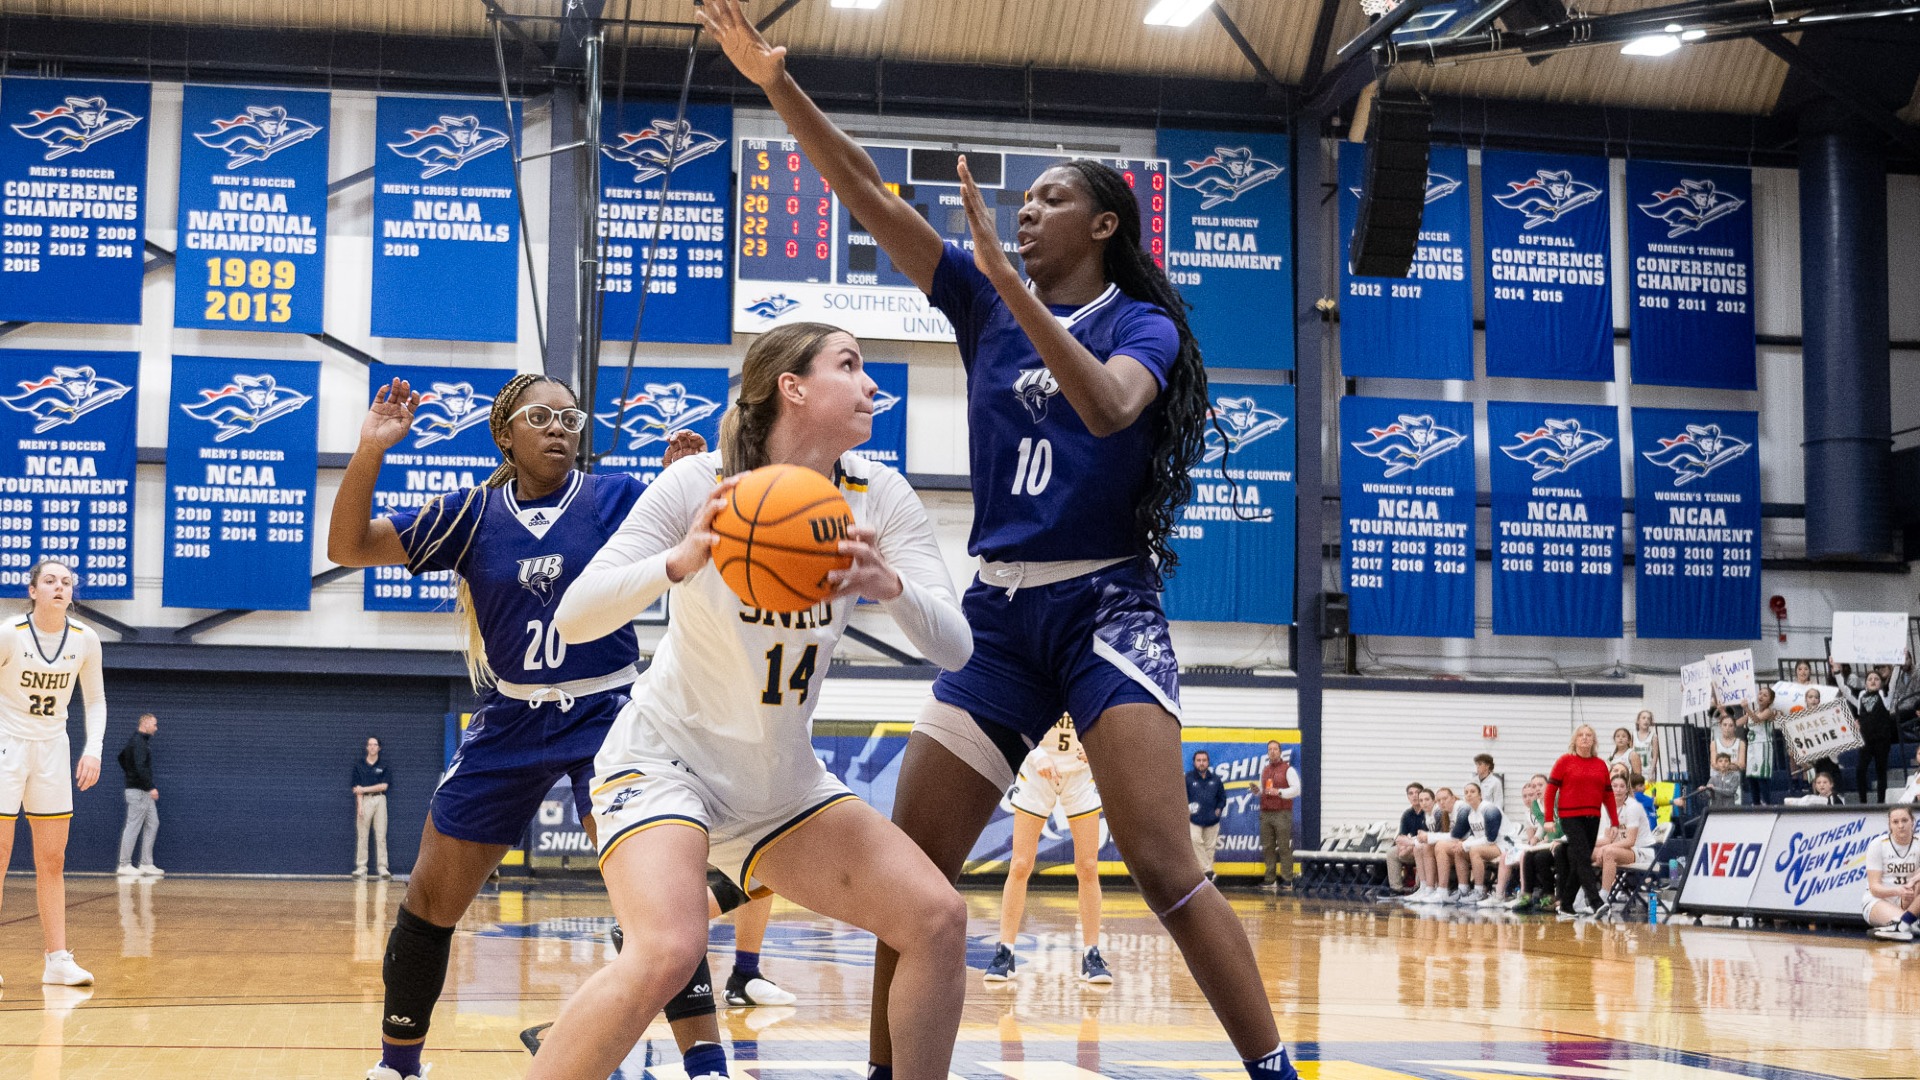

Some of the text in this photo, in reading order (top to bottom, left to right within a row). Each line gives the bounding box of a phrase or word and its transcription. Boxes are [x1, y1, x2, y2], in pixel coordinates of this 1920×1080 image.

[748, 140, 795, 152] PLYR FLS
[757, 151, 769, 170] 5
[1144, 161, 1158, 171] PTS
[30, 167, 114, 179] MEN'S SOCCER
[212, 176, 295, 188] MEN'S SOCCER
[751, 175, 769, 190] 14
[5, 181, 137, 201] CONFERENCE
[383, 184, 512, 198] MEN'S CROSS COUNTRY
[4, 199, 136, 220] CHAMPIONS
[219, 191, 287, 212] NCAA
[744, 194, 768, 213] 20
[414, 201, 481, 222] NCAA
[598, 201, 724, 223] CONFERENCE
[188, 211, 316, 235] NATIONAL
[597, 219, 723, 241] CHAMPIONS
[743, 216, 829, 238] 22 2
[1192, 216, 1258, 227] FIELD HOCKEY
[4, 223, 136, 240] 2000 2002 2008
[384, 220, 509, 242] NATIONALS
[4, 241, 132, 258] 2012 2013 2014
[186, 232, 316, 254] CHAMPIONS
[743, 238, 767, 257] 23
[1195, 232, 1256, 252] NCAA
[1519, 235, 1575, 247] SOFTBALL
[384, 244, 419, 256] 2018
[688, 249, 723, 261] 1994
[1492, 249, 1603, 268] CONFERENCE
[1648, 244, 1734, 257] WOMEN'S TENNIS
[4, 258, 39, 272] 2015
[1170, 252, 1282, 270] TOURNAMENT
[1637, 257, 1745, 277] CONFERENCE
[207, 258, 295, 289] 1989
[688, 266, 723, 278] 1999
[846, 273, 878, 285] SCORE
[1169, 272, 1201, 285] 2019
[1492, 265, 1604, 285] CHAMPIONS
[1351, 283, 1421, 298] 2012 2017
[1638, 273, 1746, 294] CHAMPIONS
[1495, 287, 1563, 302] 2014 2015
[205, 291, 292, 322] 2013
[823, 293, 920, 314] SOUTHERN
[1640, 296, 1745, 313] 2010 2011 2012
[903, 317, 955, 335] UNIVE
[19, 440, 105, 451] MEN'S SOCCER
[200, 448, 284, 460] MEN'S SOCCER
[27, 456, 97, 476] NCAA
[385, 454, 498, 467] MEN'S BASKETBALL
[601, 456, 637, 466] MEN'S
[1011, 437, 1053, 496] 10
[207, 465, 275, 486] NCAA
[407, 470, 474, 491] NCAA
[1247, 470, 1291, 481] COUNTRY
[174, 486, 306, 504] TOURNAMENT
[1197, 484, 1259, 504] NCAA
[1363, 484, 1453, 496] WOMEN'S SOCCER
[1532, 487, 1581, 497] SOFTBALL
[1655, 492, 1741, 502] WOMEN'S TENNIS
[42, 500, 127, 514] 1987 1988
[1184, 506, 1272, 522] NATIONALS
[1379, 499, 1438, 520] NCAA
[1528, 502, 1587, 521] NCAA
[176, 508, 304, 524] 2010 2011 2012
[1670, 507, 1726, 525] NCAA
[42, 518, 126, 532] 1990 1992
[1350, 519, 1467, 538] TOURNAMENT
[1500, 522, 1614, 539] TOURNAMENT
[176, 526, 303, 542] 2013 2014 2015
[1643, 527, 1753, 542] TOURNAMENT
[42, 537, 126, 550] 1997 1998
[175, 544, 210, 557] 2016
[1352, 540, 1465, 556] 1997 2003 2012
[1543, 543, 1574, 556] 2014
[1582, 545, 1611, 557] 2015
[87, 555, 126, 568] 2002
[1644, 547, 1750, 560] 2009 2010 2011
[1352, 557, 1382, 569] 2017
[1503, 559, 1533, 571] 2016
[1581, 562, 1611, 574] 2019
[1646, 563, 1750, 577] 2012 2013 2017
[88, 573, 126, 586] 2009
[1352, 575, 1382, 587] 2021
[375, 585, 411, 598] 1999
[523, 619, 567, 671] 20
[761, 643, 818, 706] 14
[1725, 660, 1750, 676] WANT
[20, 670, 71, 689] SNHU
[29, 694, 56, 717] 22
[1795, 716, 1829, 733] MAKE
[1058, 733, 1071, 751] 5
[1775, 817, 1866, 873] SOUTHERN
[1693, 843, 1762, 878] NE10
[1887, 863, 1916, 874] SNHU
[1784, 852, 1830, 893] NEW
[1794, 865, 1868, 906] UNIVERS
